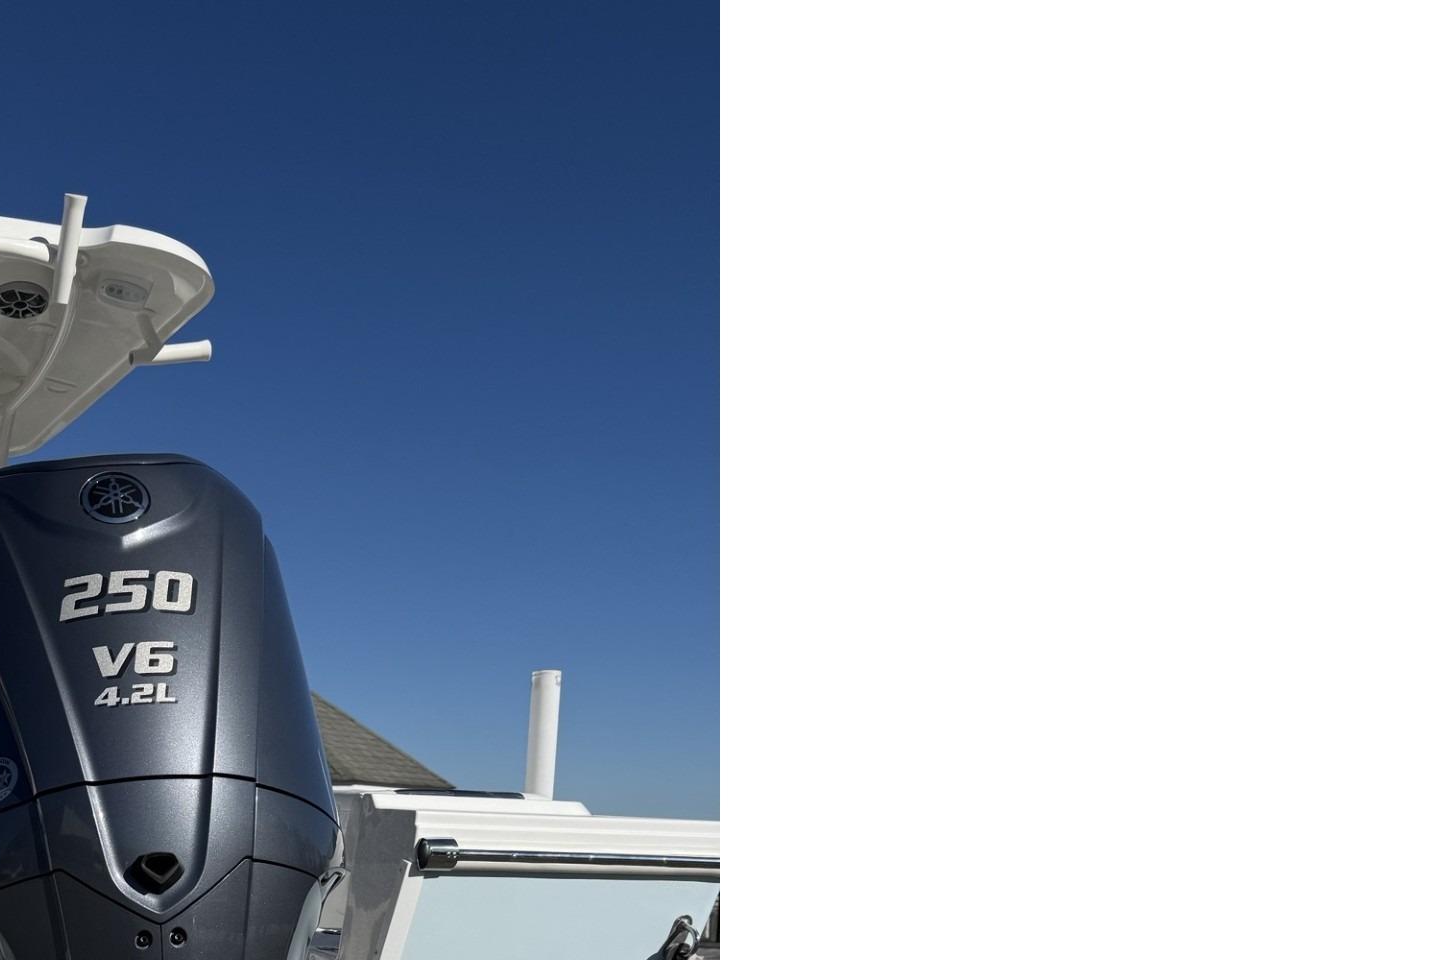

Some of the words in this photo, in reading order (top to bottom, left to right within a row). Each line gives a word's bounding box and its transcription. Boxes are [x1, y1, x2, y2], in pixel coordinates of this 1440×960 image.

[60, 569, 194, 621] 250
[92, 641, 174, 677] V6
[94, 682, 176, 706] 4.2L
